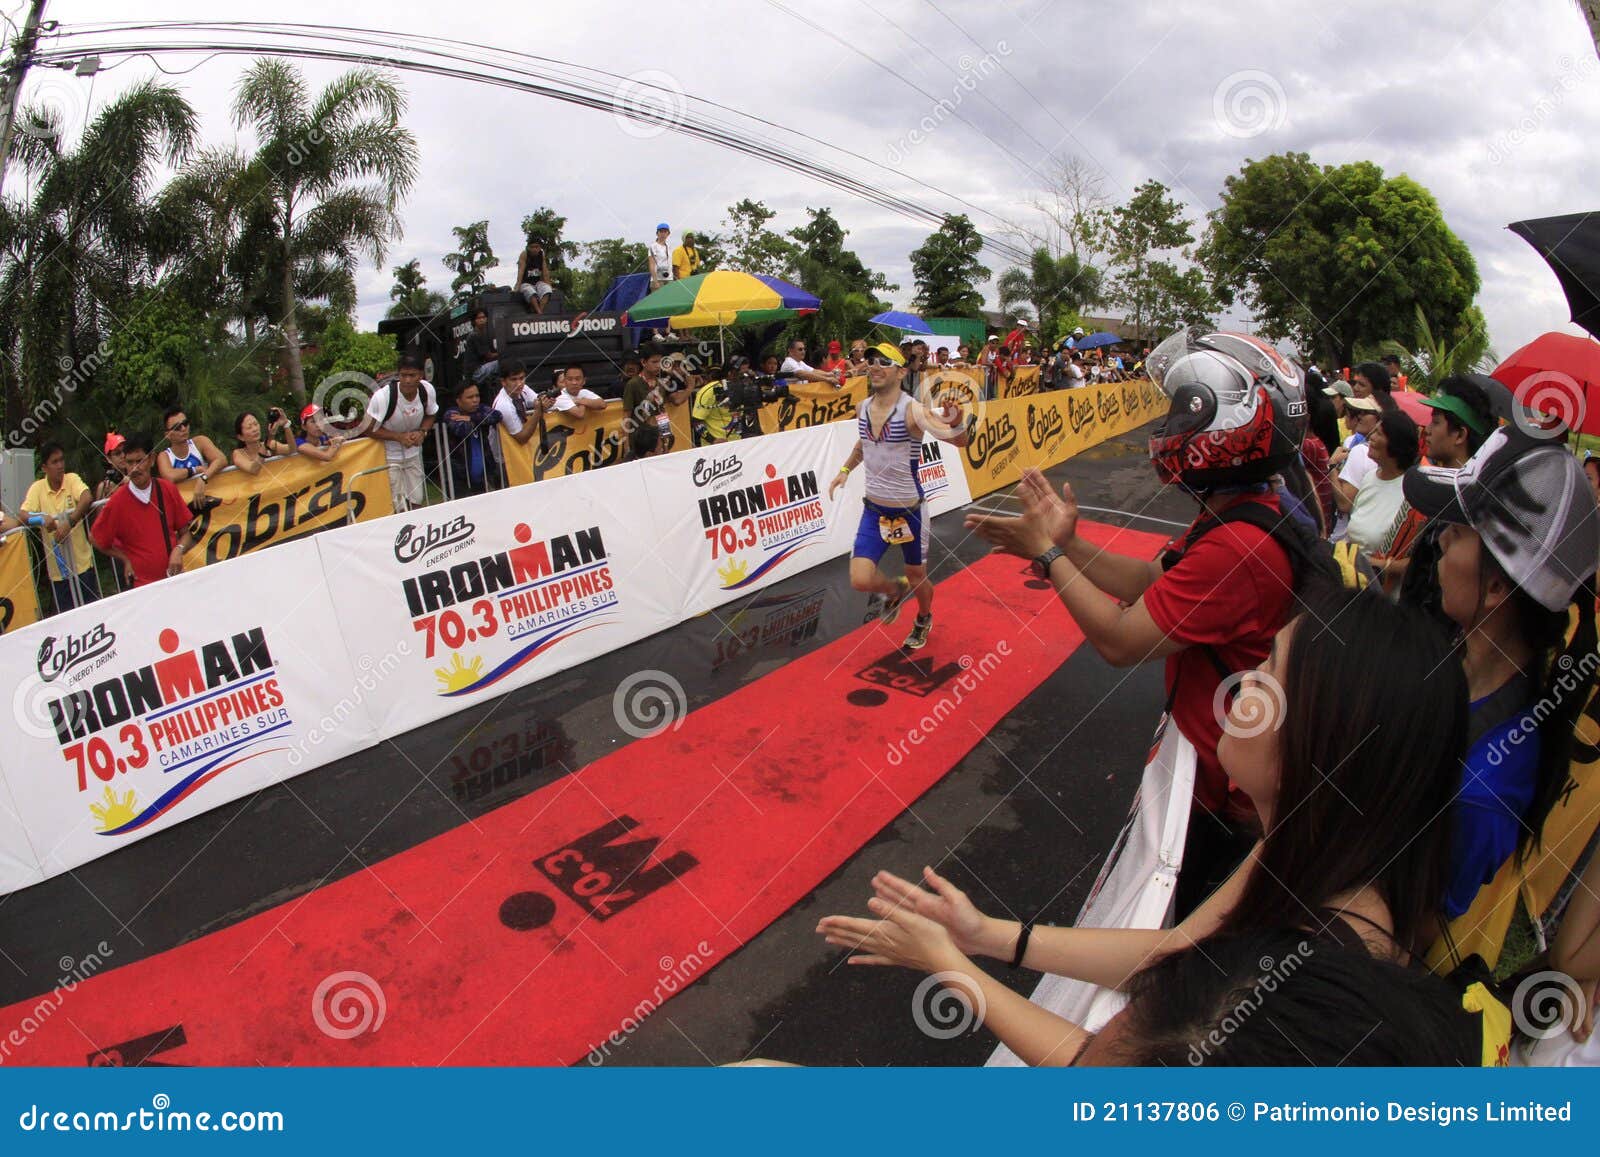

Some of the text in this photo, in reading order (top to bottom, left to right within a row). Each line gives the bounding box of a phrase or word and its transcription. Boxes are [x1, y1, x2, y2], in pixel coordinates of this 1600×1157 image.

[512, 319, 570, 337] TOURING
[965, 412, 1017, 470] Cobra
[1027, 404, 1063, 450] Cobra
[1068, 395, 1095, 434] Cobra
[693, 454, 742, 487] Cobra
[698, 464, 818, 528] IRONMAN
[394, 514, 475, 564] Cobra
[426, 536, 476, 568] ENERGY DRINK
[705, 501, 823, 560] 70.3 PHILIPPINES
[762, 518, 826, 547] CAMARINES SUR
[402, 523, 607, 618] IRONMAN
[413, 567, 613, 659] 70.3 PHILIPPINES
[507, 591, 617, 636] CAMARINES SUR
[37, 622, 116, 683] Cobra
[68, 648, 118, 687] ENERGY DRINK
[47, 626, 274, 746] IRONMAN
[62, 678, 284, 792] 70.3 PHILIPPINES
[159, 708, 290, 766] CAMARINES SUR
